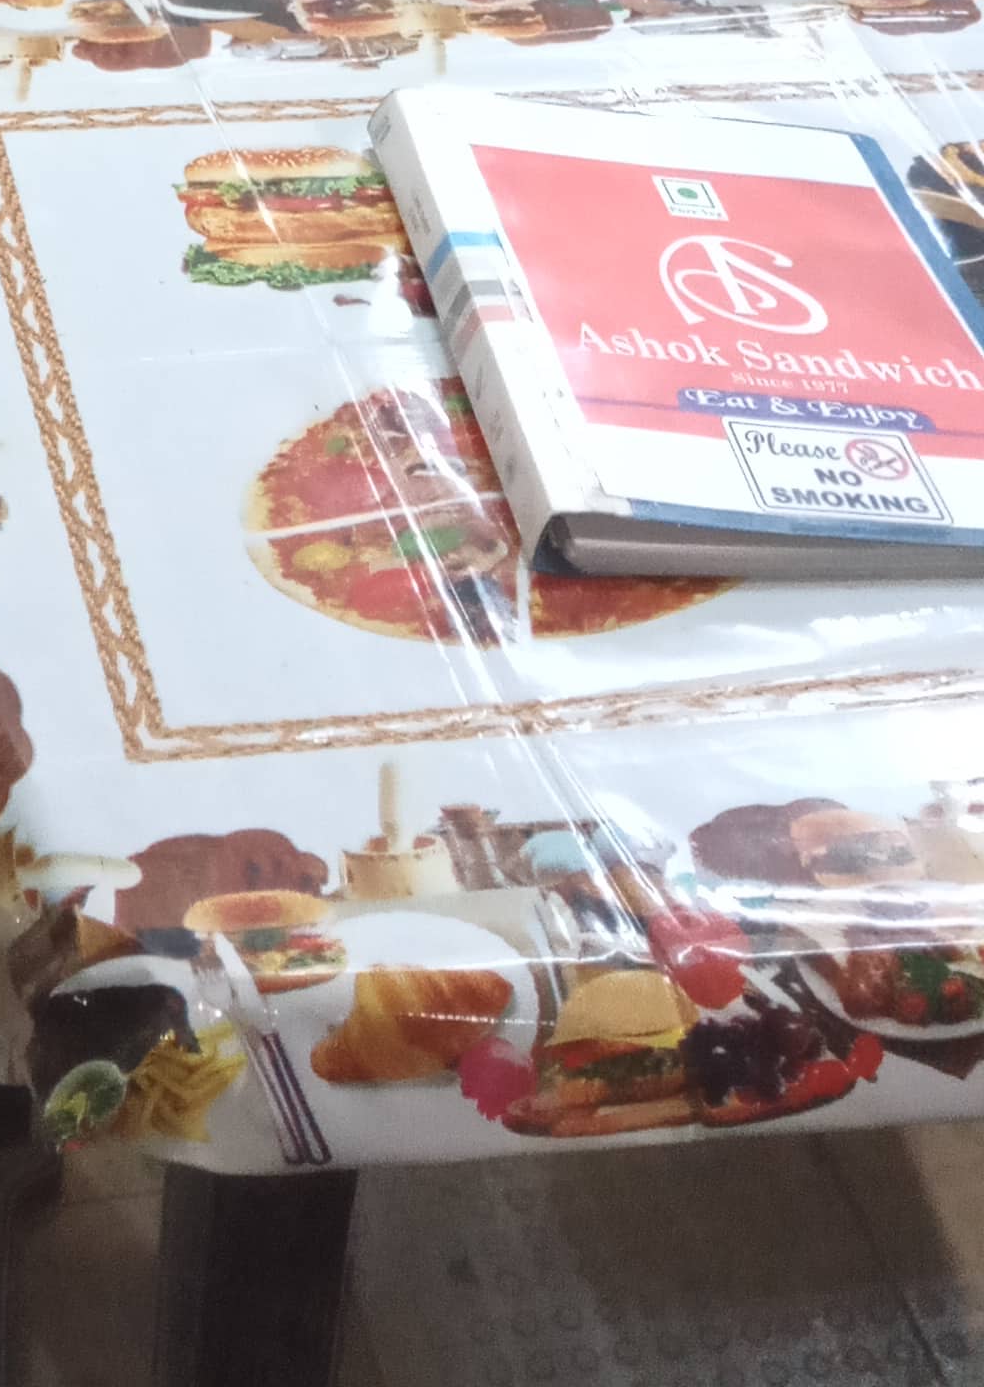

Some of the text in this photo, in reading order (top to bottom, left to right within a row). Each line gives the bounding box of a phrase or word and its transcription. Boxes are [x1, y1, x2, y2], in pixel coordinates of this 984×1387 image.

[578, 322, 984, 393] Ashok Sandwich
[731, 371, 849, 394] Since 1977
[685, 388, 924, 430] Eat & Enjoy
[744, 429, 842, 461] Please
[813, 468, 863, 488] NO
[770, 486, 931, 514] SMOKING
